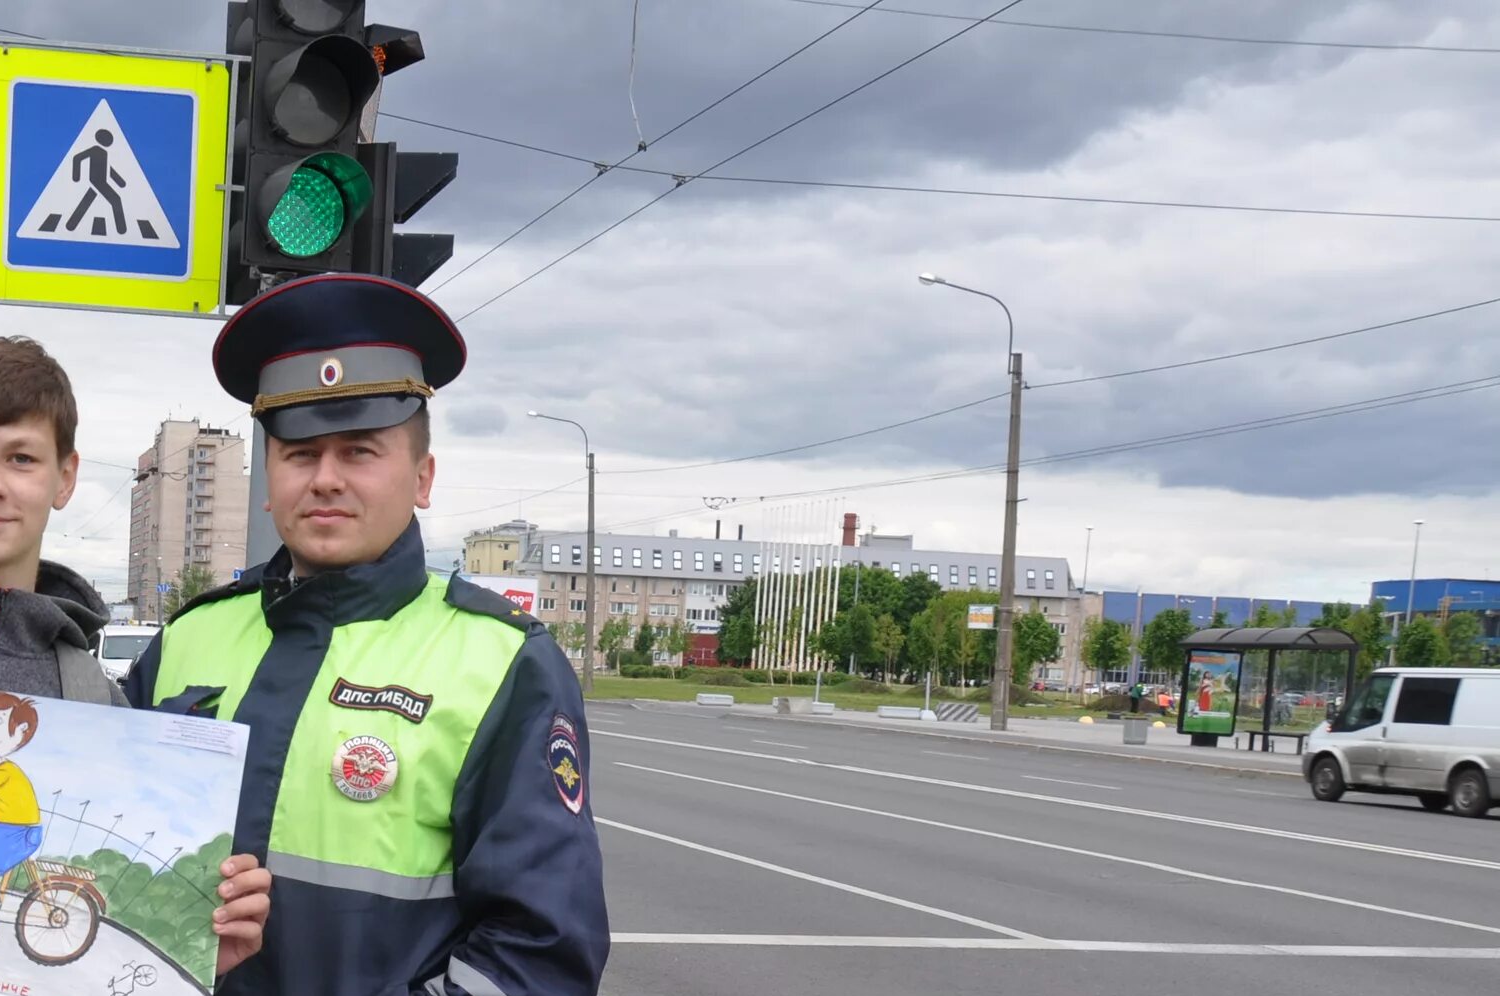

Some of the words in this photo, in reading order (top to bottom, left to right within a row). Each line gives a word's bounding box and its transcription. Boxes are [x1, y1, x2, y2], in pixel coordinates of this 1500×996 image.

[337, 688, 373, 704] ДПС
[373, 690, 425, 718] ГИБДД
[345, 736, 395, 762] ПОЛИЦИЯ
[349, 774, 372, 788] ДПС
